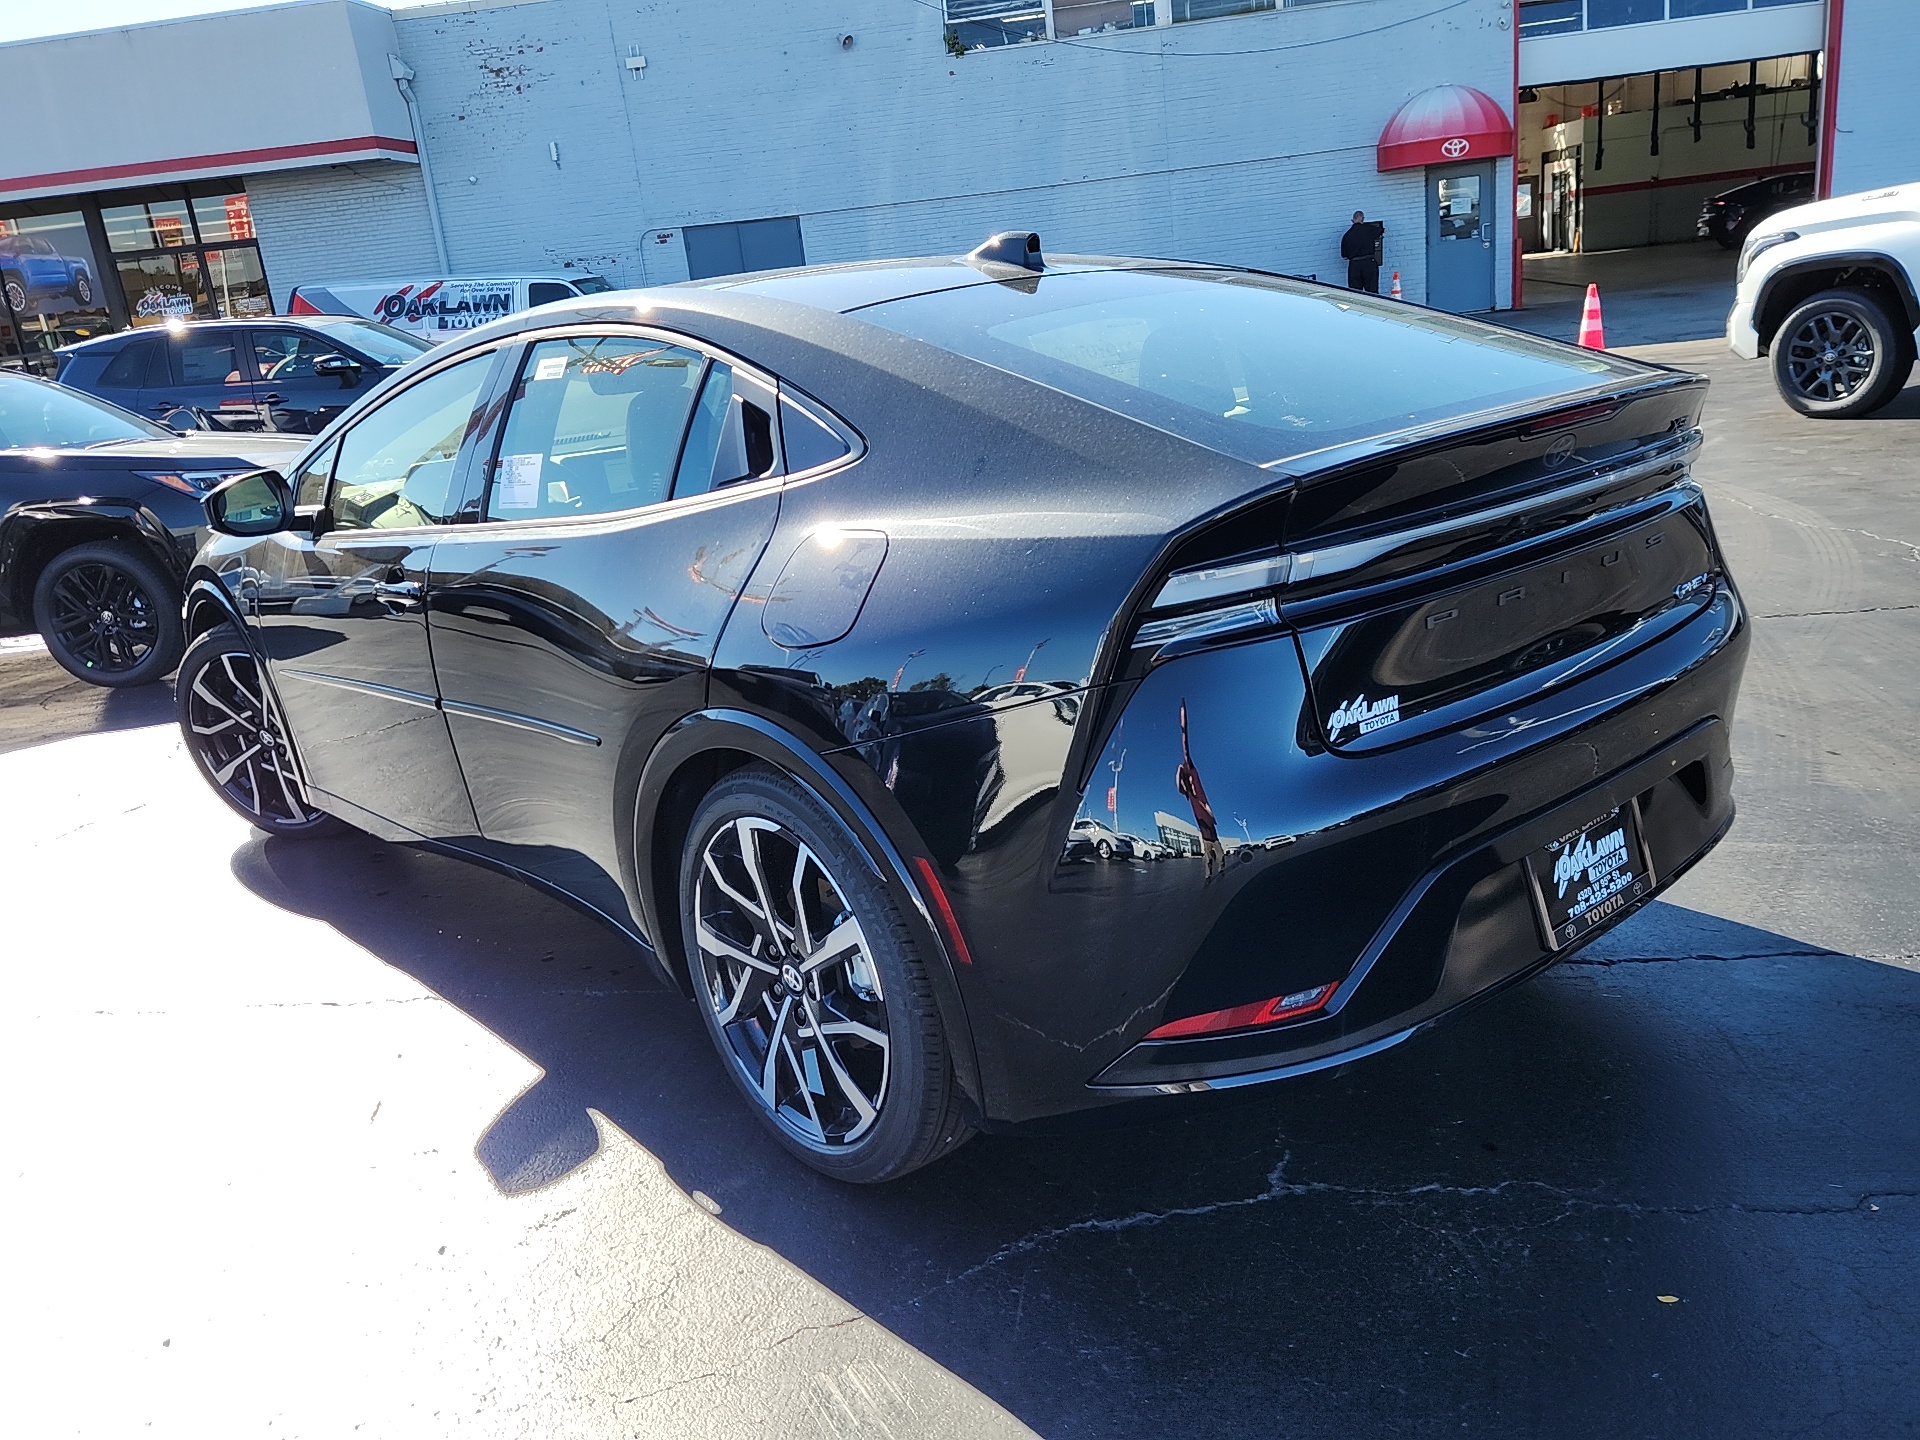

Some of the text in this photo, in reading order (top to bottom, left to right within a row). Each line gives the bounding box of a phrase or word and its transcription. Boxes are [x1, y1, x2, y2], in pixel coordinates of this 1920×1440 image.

[165, 306, 191, 314] TOYOTA
[1425, 531, 1666, 630] PRIUS
[1364, 713, 1397, 731] TOYOTA
[1591, 853, 1624, 878] TOYOTA
[1592, 881, 1600, 892] W
[1612, 869, 1621, 880] St
[1584, 893, 1625, 926] TOYOTA
